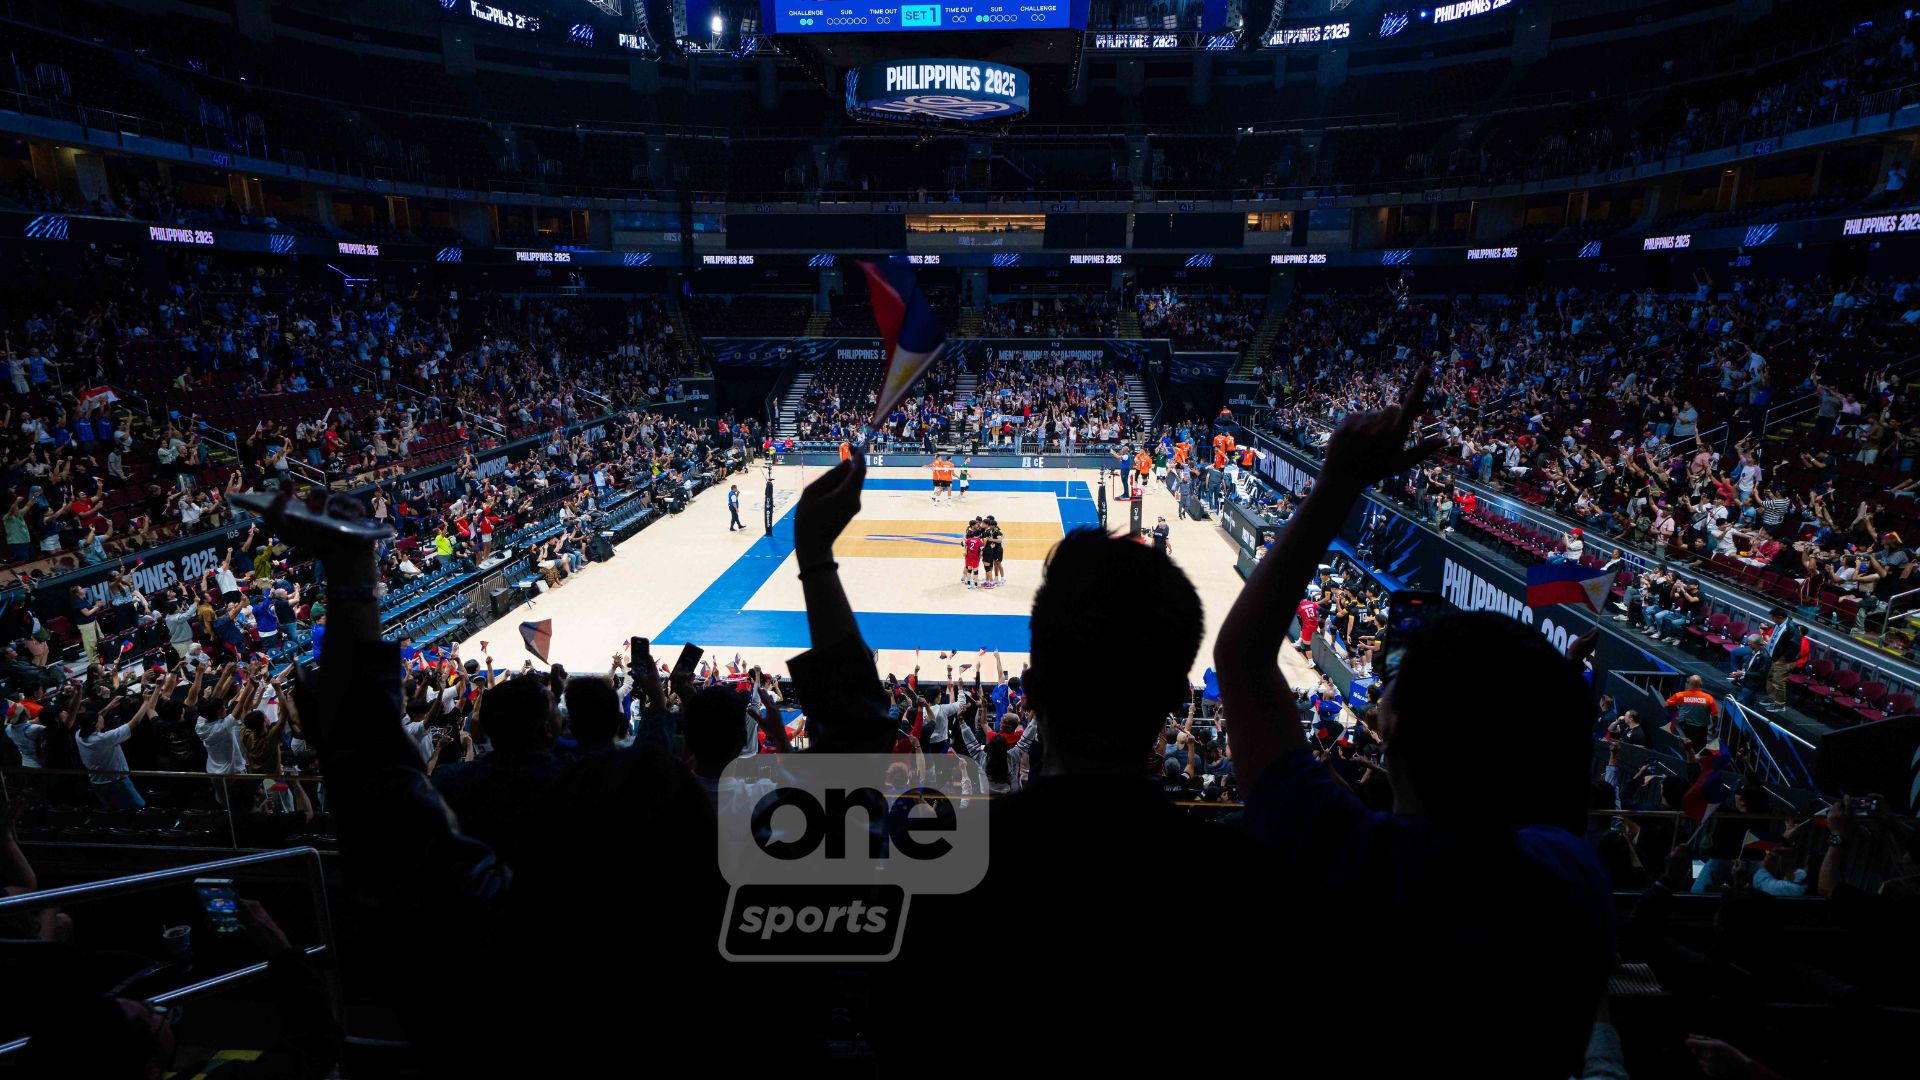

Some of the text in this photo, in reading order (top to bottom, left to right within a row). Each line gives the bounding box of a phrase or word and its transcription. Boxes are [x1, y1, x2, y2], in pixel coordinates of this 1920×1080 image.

[905, 8, 936, 22] SET 1
[886, 64, 1016, 97] PHILIPPINES 2025
[1842, 215, 1898, 236] PHILIPPINES
[149, 227, 214, 245] PHILIPPINES 2025
[1643, 234, 1692, 250] PHILIPPINES 2025
[516, 252, 571, 262] PHILIPPINES 2025
[1467, 247, 1518, 260] PHILIPPINES 2025
[703, 255, 753, 265] PHILIPPINES 2025
[924, 255, 940, 265] 2025
[1069, 254, 1122, 264] PHILIPPINES 2025
[1270, 254, 1327, 264] PHILIPPINES 2025
[837, 349, 878, 359] PHILIPPINES
[226, 530, 240, 540] 105
[1304, 607, 1315, 618] 13
